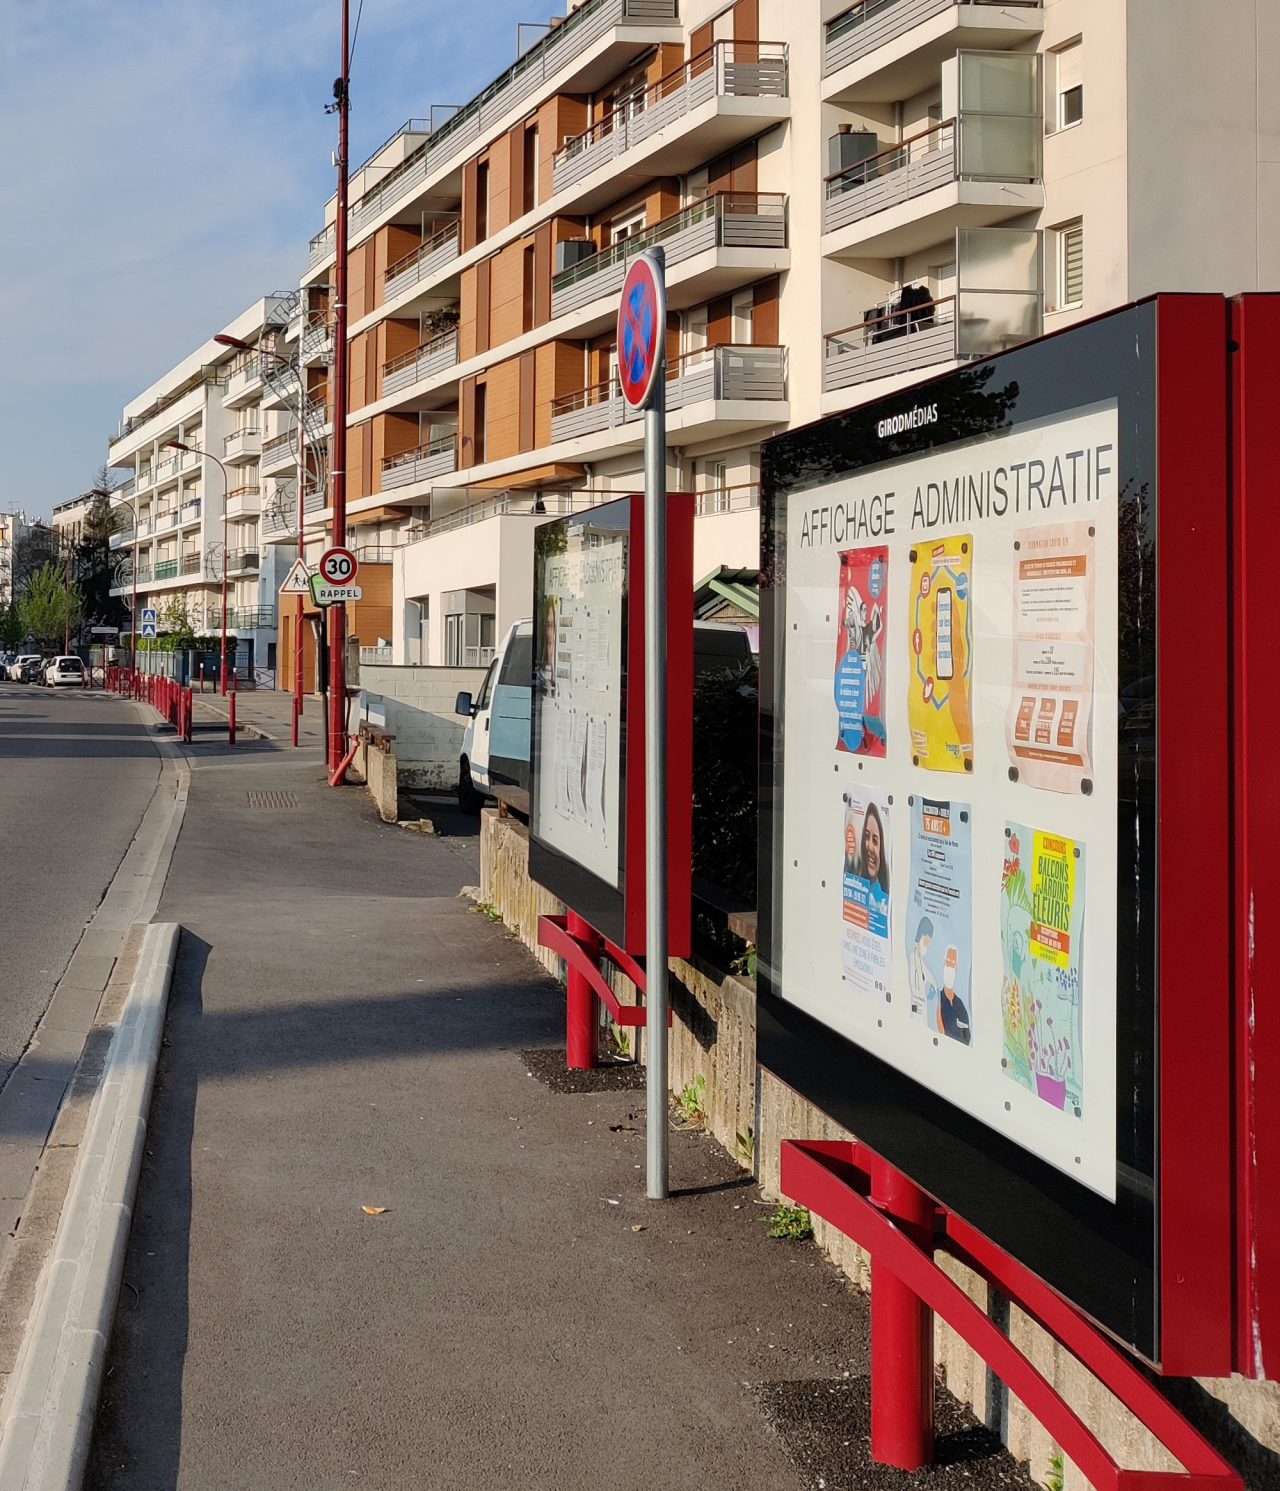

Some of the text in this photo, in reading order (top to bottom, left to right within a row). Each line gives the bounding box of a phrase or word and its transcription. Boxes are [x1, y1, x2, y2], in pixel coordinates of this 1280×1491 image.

[878, 403, 938, 438] GIRODMÉDIAS
[800, 444, 1113, 548] AFFICHAGE ADMINISTRATIF
[327, 558, 351, 575] 30
[1038, 856, 1068, 882] BALCONS
[1040, 879, 1068, 902] JARDINS
[1033, 893, 1069, 931] FLEURIS
